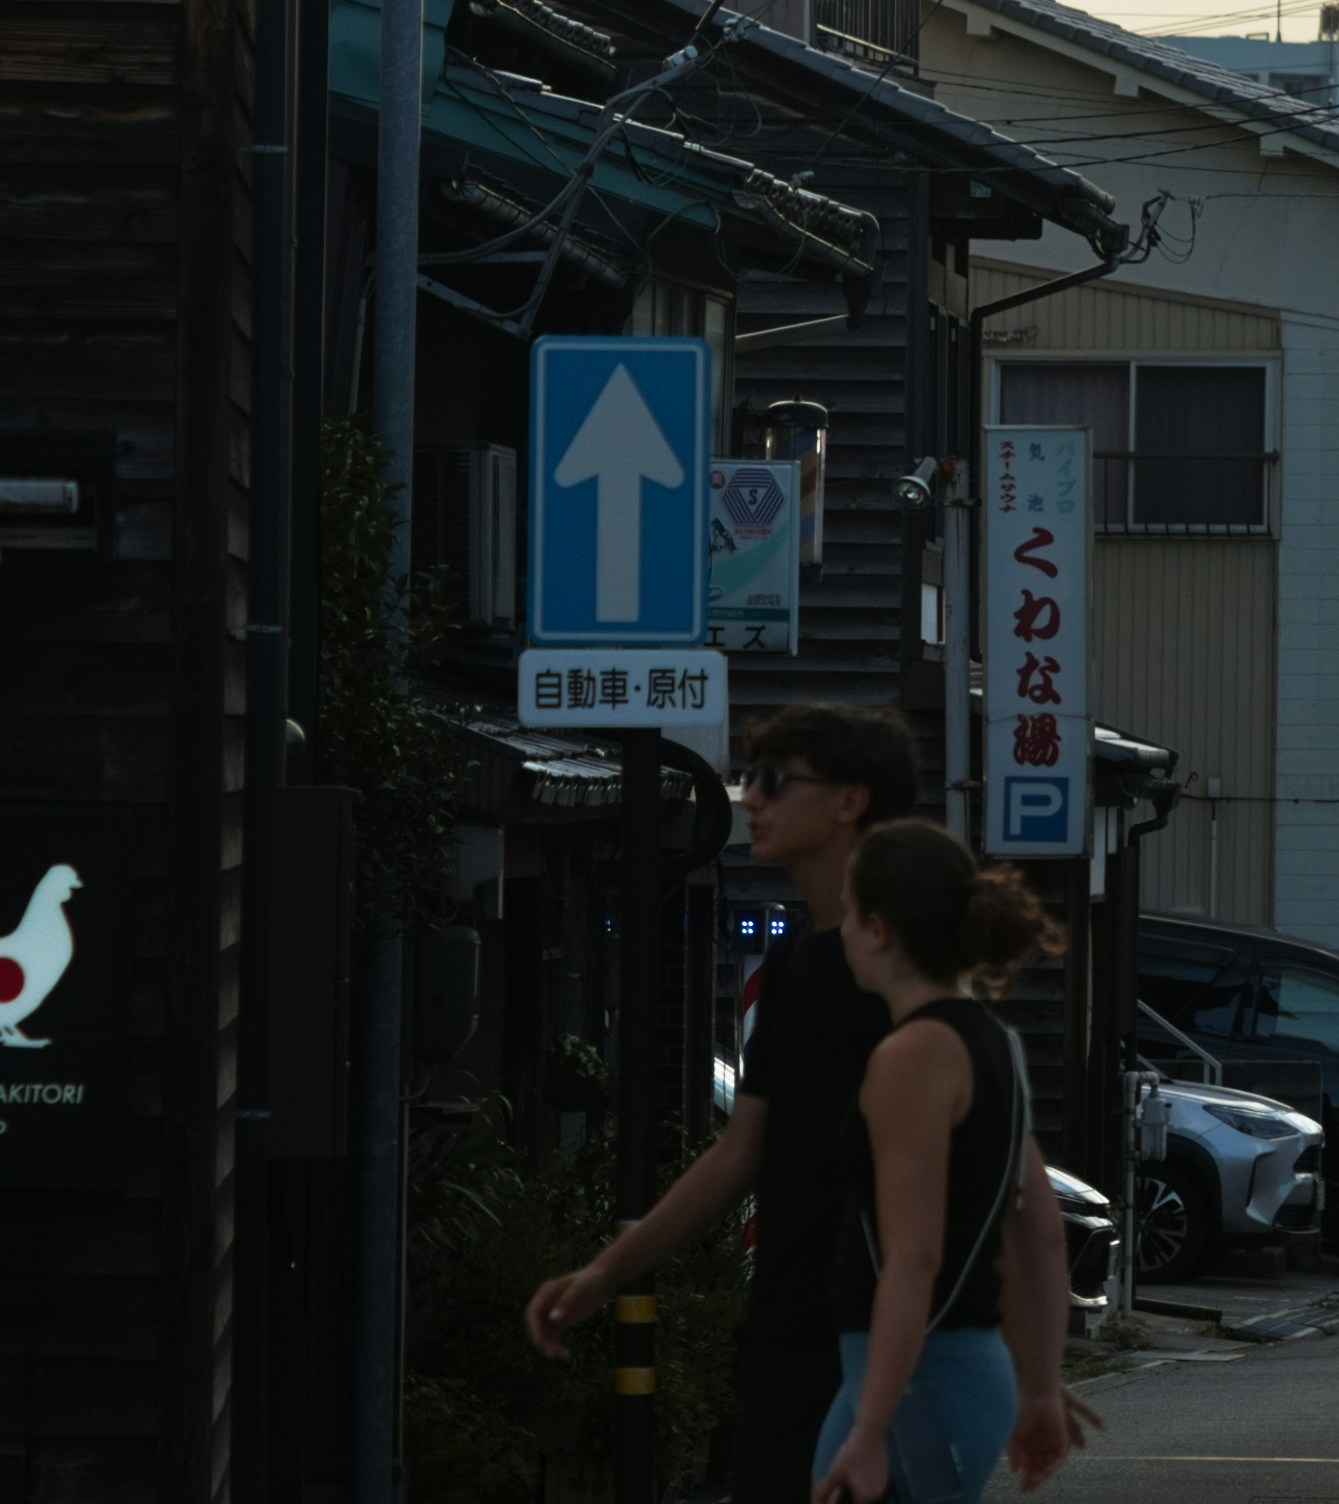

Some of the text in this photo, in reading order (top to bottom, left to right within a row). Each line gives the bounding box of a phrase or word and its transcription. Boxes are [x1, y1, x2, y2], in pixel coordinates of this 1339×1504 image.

[1013, 527, 1062, 767] くわな湯
[535, 668, 709, 710] 自動車・原付
[1008, 783, 1063, 835] P
